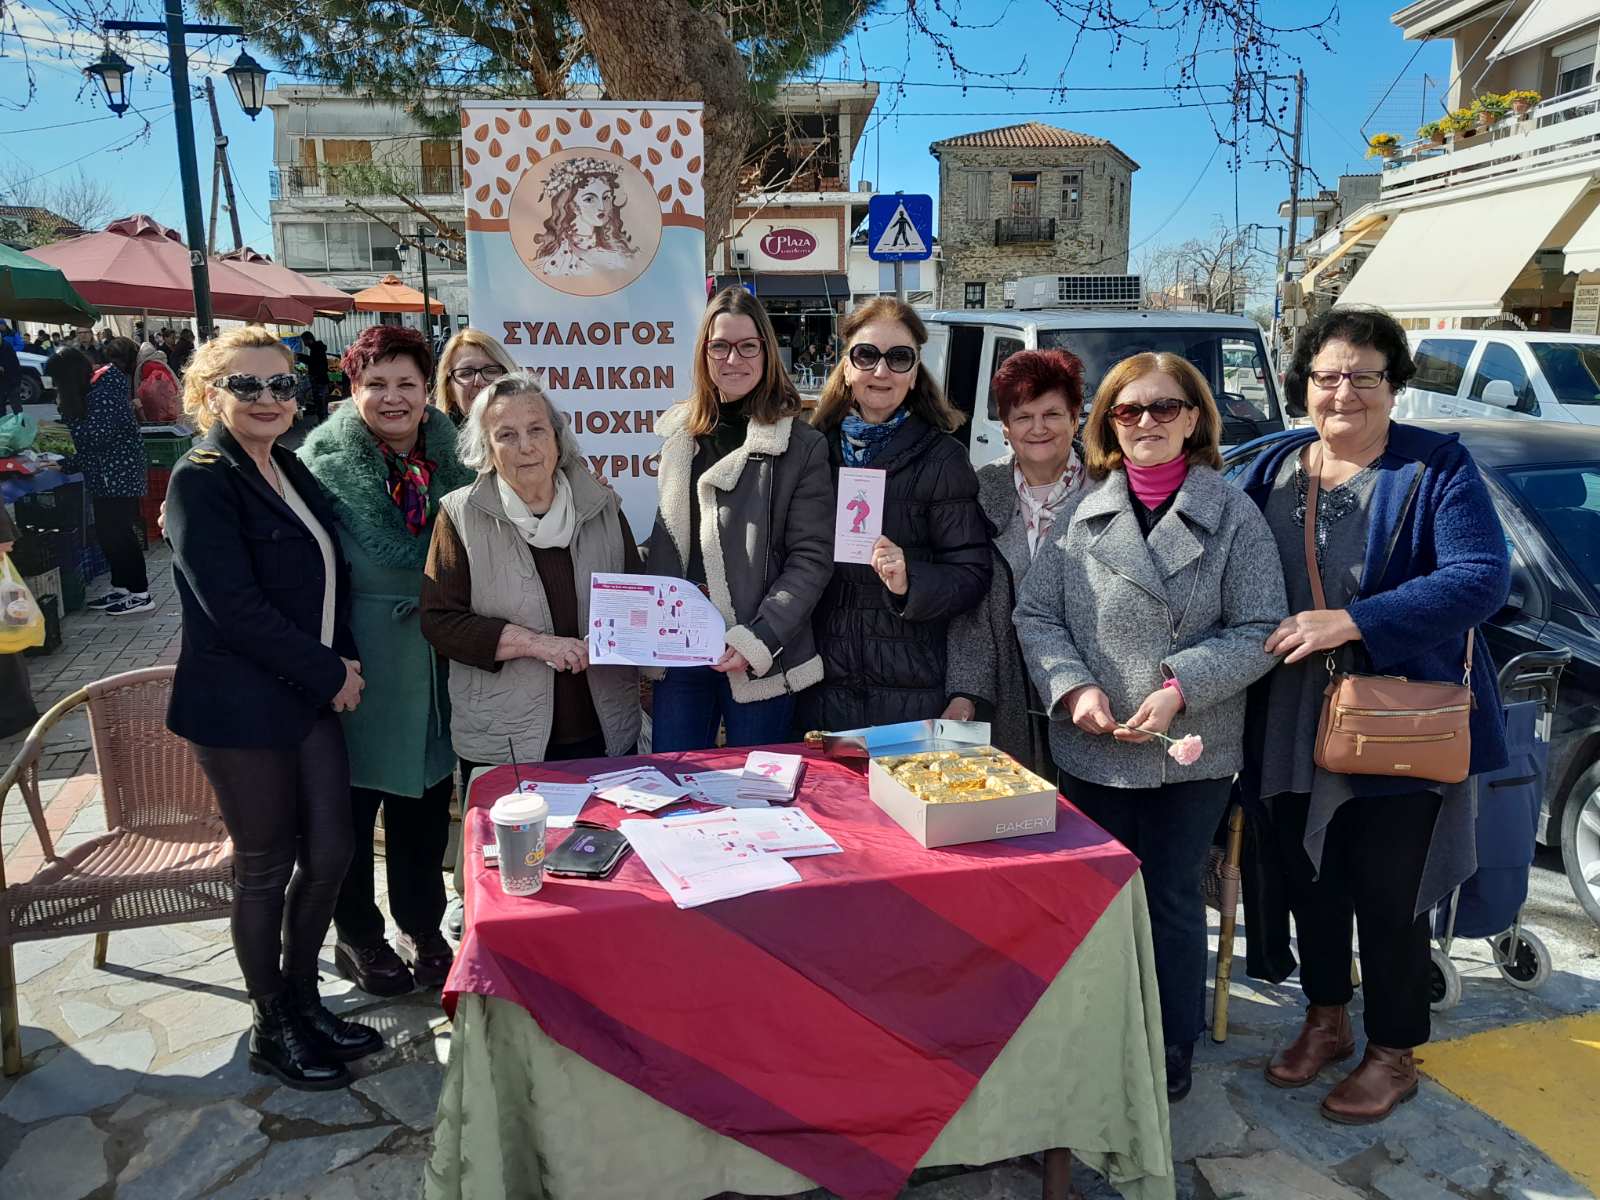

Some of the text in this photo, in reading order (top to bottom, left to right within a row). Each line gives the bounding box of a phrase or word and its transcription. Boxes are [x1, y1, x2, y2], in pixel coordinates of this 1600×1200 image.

[503, 321, 675, 345] ΣΥΛΛΟΓΟΣ
[520, 366, 674, 389] ΥΝΑΙΚΩΝ
[563, 410, 668, 434] ΙΟΧΗ
[579, 454, 662, 478] ΥΡΙΟ
[995, 816, 1052, 834] BAKERY
